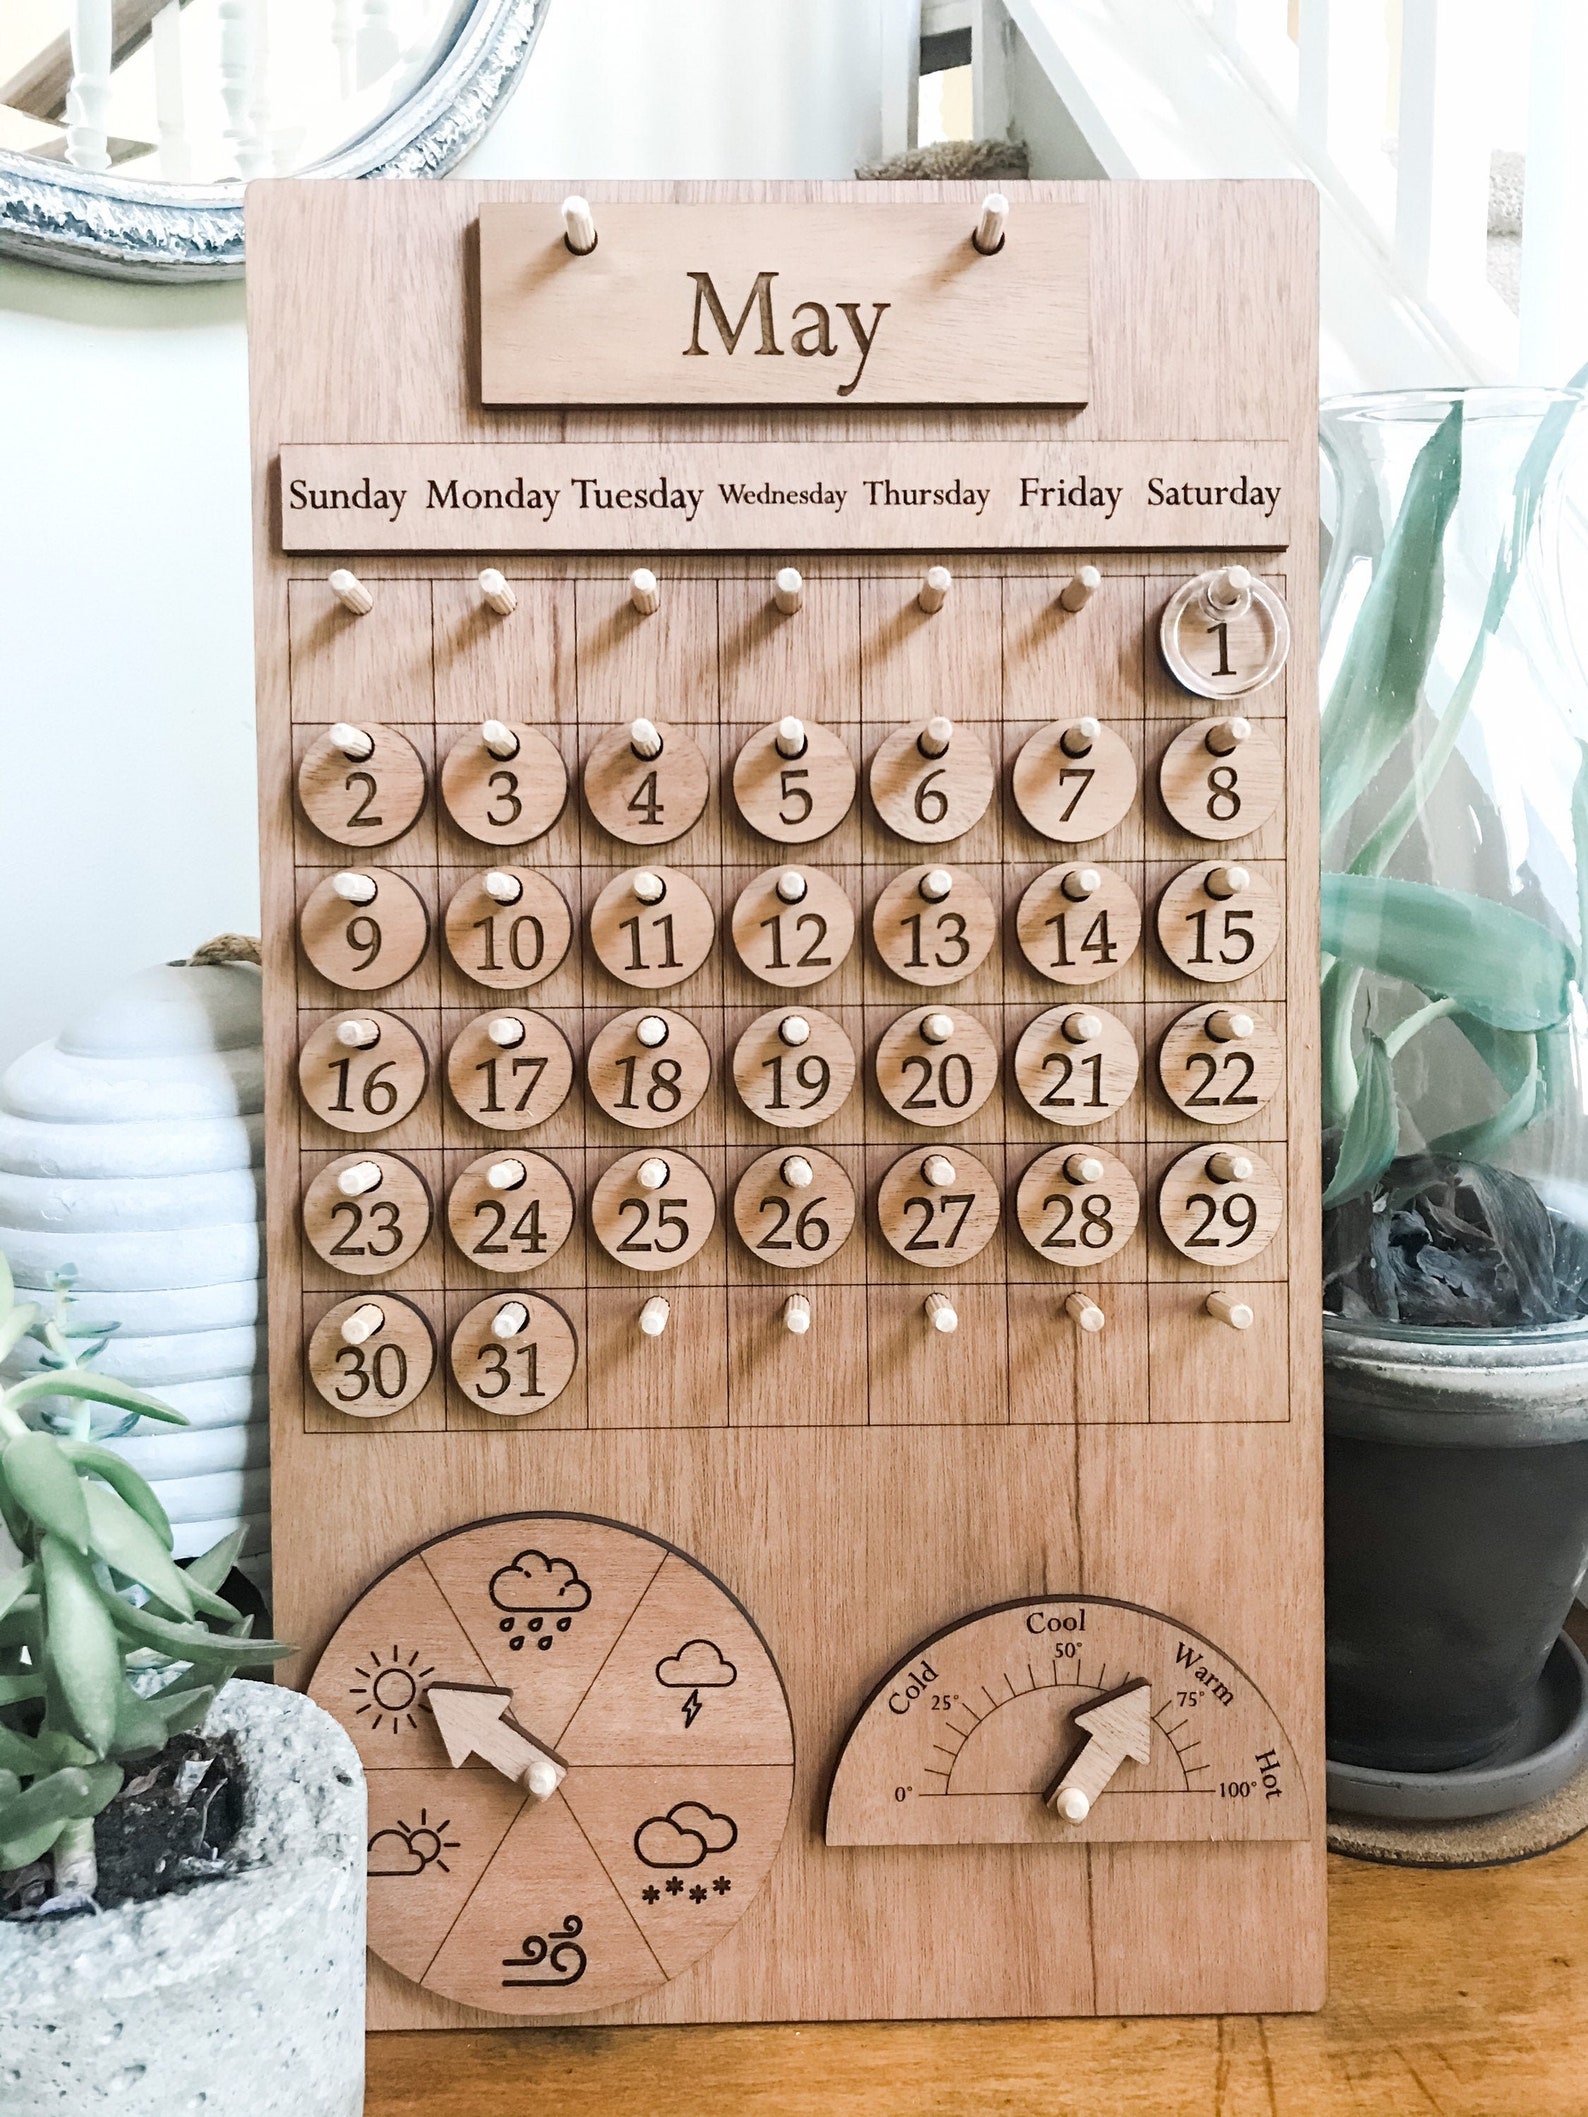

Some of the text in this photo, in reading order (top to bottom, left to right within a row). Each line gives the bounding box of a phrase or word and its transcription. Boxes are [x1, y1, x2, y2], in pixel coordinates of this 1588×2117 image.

[682, 271, 891, 397] May
[289, 475, 1282, 522] Sunday Monday Tuesday Wednesday Thursday Friday Saturday
[1207, 622, 1238, 677] 1
[344, 771, 383, 828] 2
[486, 770, 522, 826] 3
[626, 771, 664, 825] 4
[775, 768, 815, 825] 5
[913, 768, 949, 824] 6
[1057, 767, 1096, 823] 7
[1205, 765, 1242, 821] 8
[345, 916, 382, 972] 9
[474, 914, 544, 971] 10
[618, 914, 683, 971] 11
[760, 910, 832, 969] 12
[900, 912, 970, 968] 13
[1045, 909, 1118, 967] 14
[1186, 909, 1256, 965] 15
[327, 1057, 398, 1116] 16
[476, 1057, 549, 1113] 17
[614, 1056, 682, 1113] 18
[761, 1054, 831, 1111] 19
[900, 1054, 972, 1110] 20
[1039, 1052, 1110, 1108] 21
[1183, 1051, 1259, 1107] 22
[329, 1201, 404, 1257] 23
[471, 1200, 547, 1254] 24
[616, 1197, 689, 1253] 25
[757, 1195, 830, 1252] 26
[903, 1194, 977, 1250] 27
[1041, 1193, 1114, 1248] 28
[1183, 1192, 1257, 1248] 29
[335, 1344, 408, 1401] 30
[475, 1343, 546, 1399] 31
[1026, 1608, 1086, 1634] Cool
[1054, 1643, 1083, 1660] 50°
[1174, 1642, 1235, 1707] Warm
[887, 1660, 939, 1716] Cold
[931, 1695, 959, 1711] 25°
[1176, 1691, 1205, 1708] 75°
[894, 1786, 913, 1801] 0°
[1219, 1781, 1258, 1799] 100°
[1254, 1748, 1283, 1799] Hot
